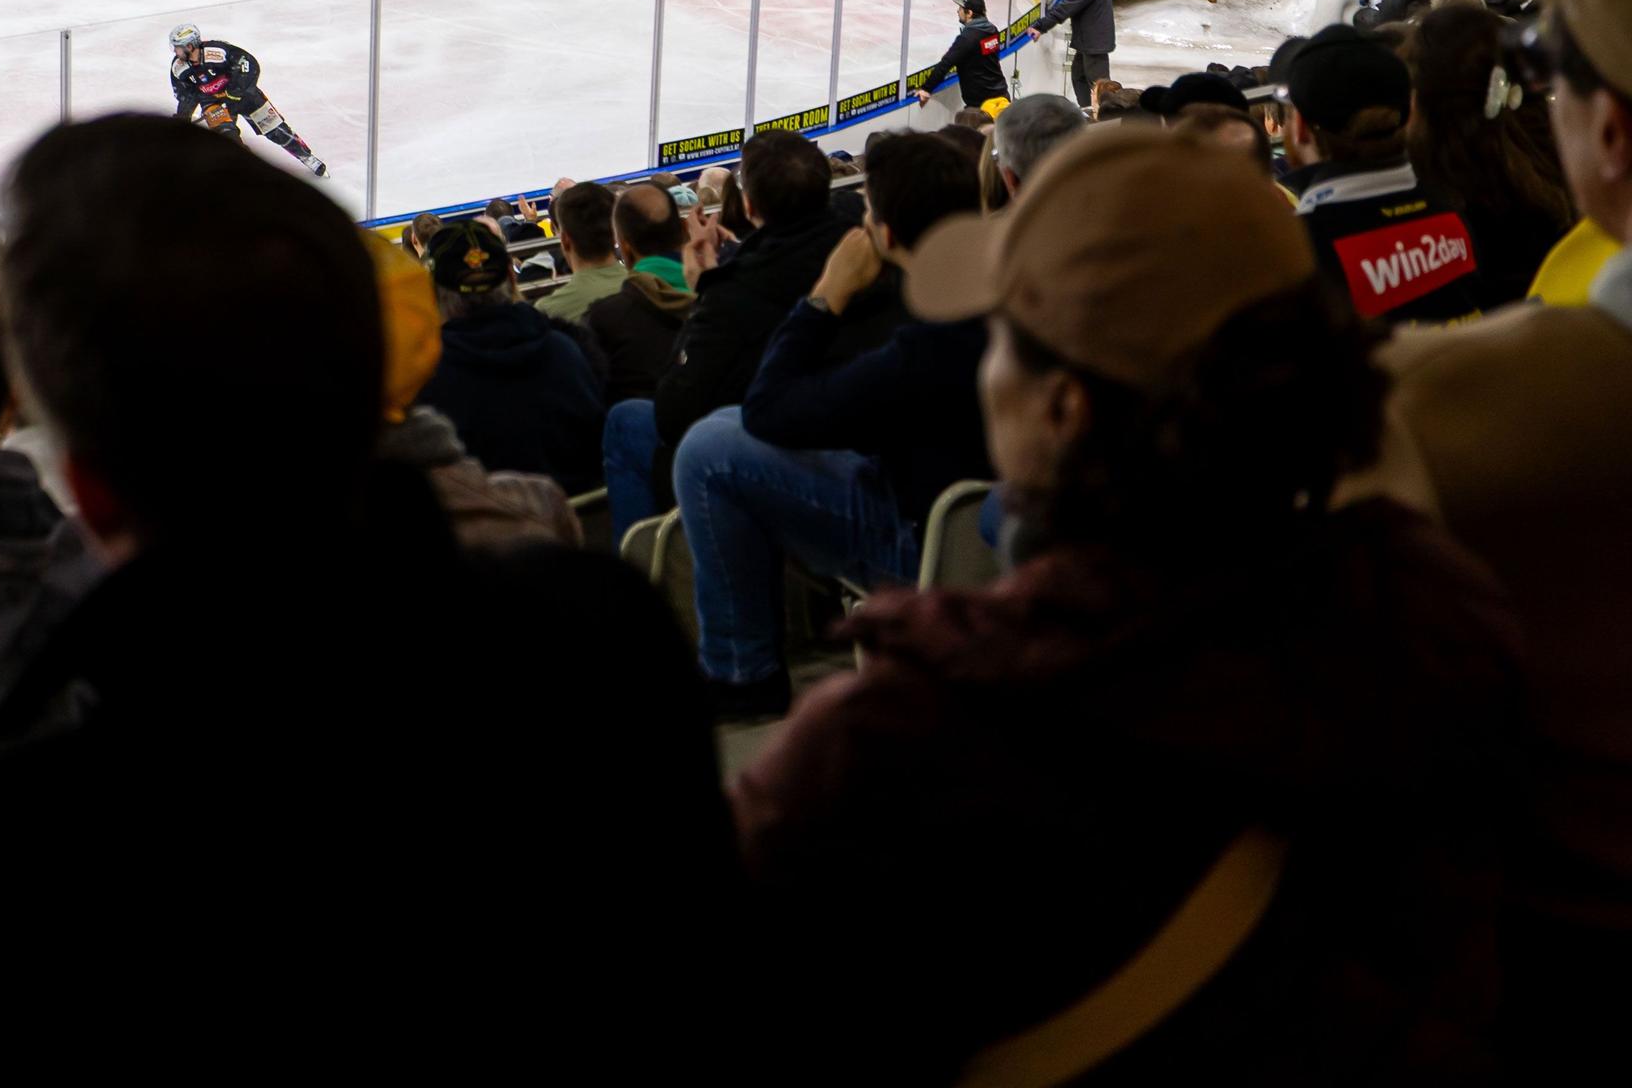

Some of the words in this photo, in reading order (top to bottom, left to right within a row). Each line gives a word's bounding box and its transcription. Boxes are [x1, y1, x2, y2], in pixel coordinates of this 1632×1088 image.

[840, 100, 851, 113] GET
[851, 93, 872, 111] SOCIAL
[873, 86, 887, 106] WITH
[887, 83, 897, 96] US
[802, 107, 829, 129] ROOM
[663, 144, 677, 157] GET
[679, 138, 707, 153] SOCIAL
[708, 133, 728, 147] WITH
[730, 130, 741, 143] US
[1361, 234, 1467, 295] win2day
